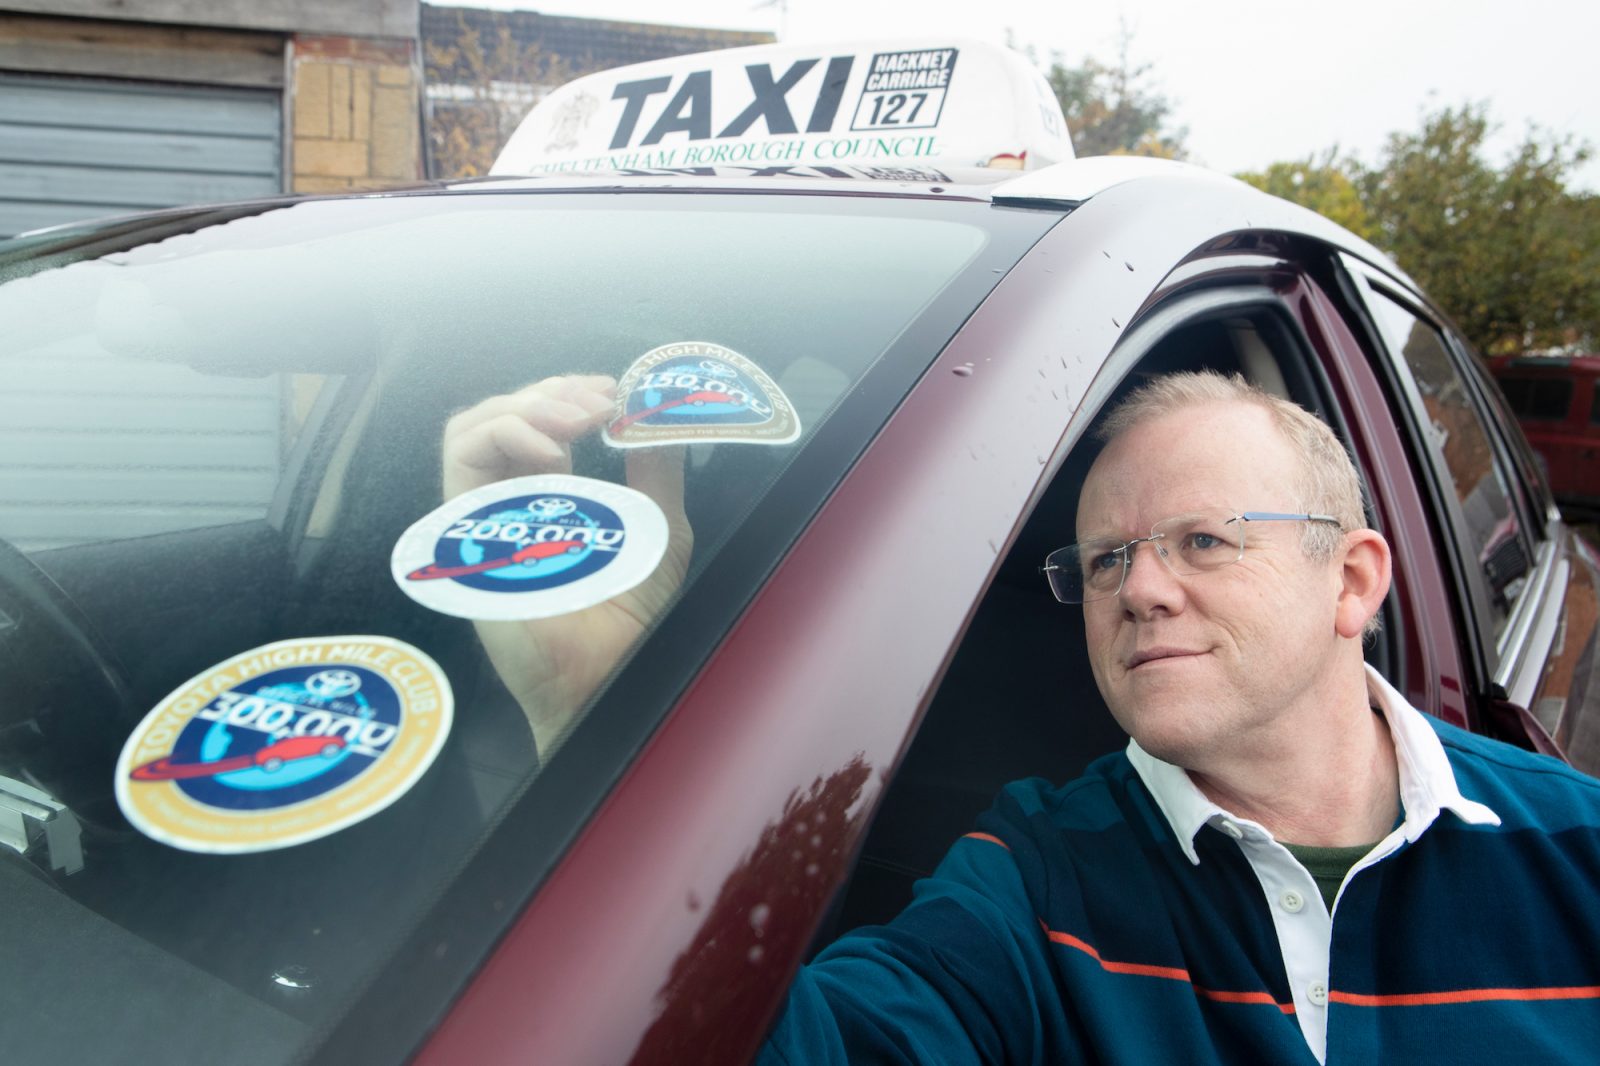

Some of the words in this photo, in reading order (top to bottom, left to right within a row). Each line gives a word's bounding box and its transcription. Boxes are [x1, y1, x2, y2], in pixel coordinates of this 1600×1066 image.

[867, 68, 950, 91] CARRIAGE
[874, 50, 953, 72] HACKNEY
[607, 55, 855, 150] TAXI
[870, 92, 928, 126] 127
[529, 150, 676, 174] CHELTENHAM
[683, 140, 805, 165] BOROUGH
[813, 136, 941, 160] COUNCIL
[643, 345, 699, 365] HIGH
[705, 347, 753, 374] MILE
[753, 374, 789, 413] CLUB
[133, 672, 235, 762] TOYOTA
[238, 645, 322, 678] HIGH
[327, 644, 400, 669] MILE
[389, 660, 438, 715] CLUB
